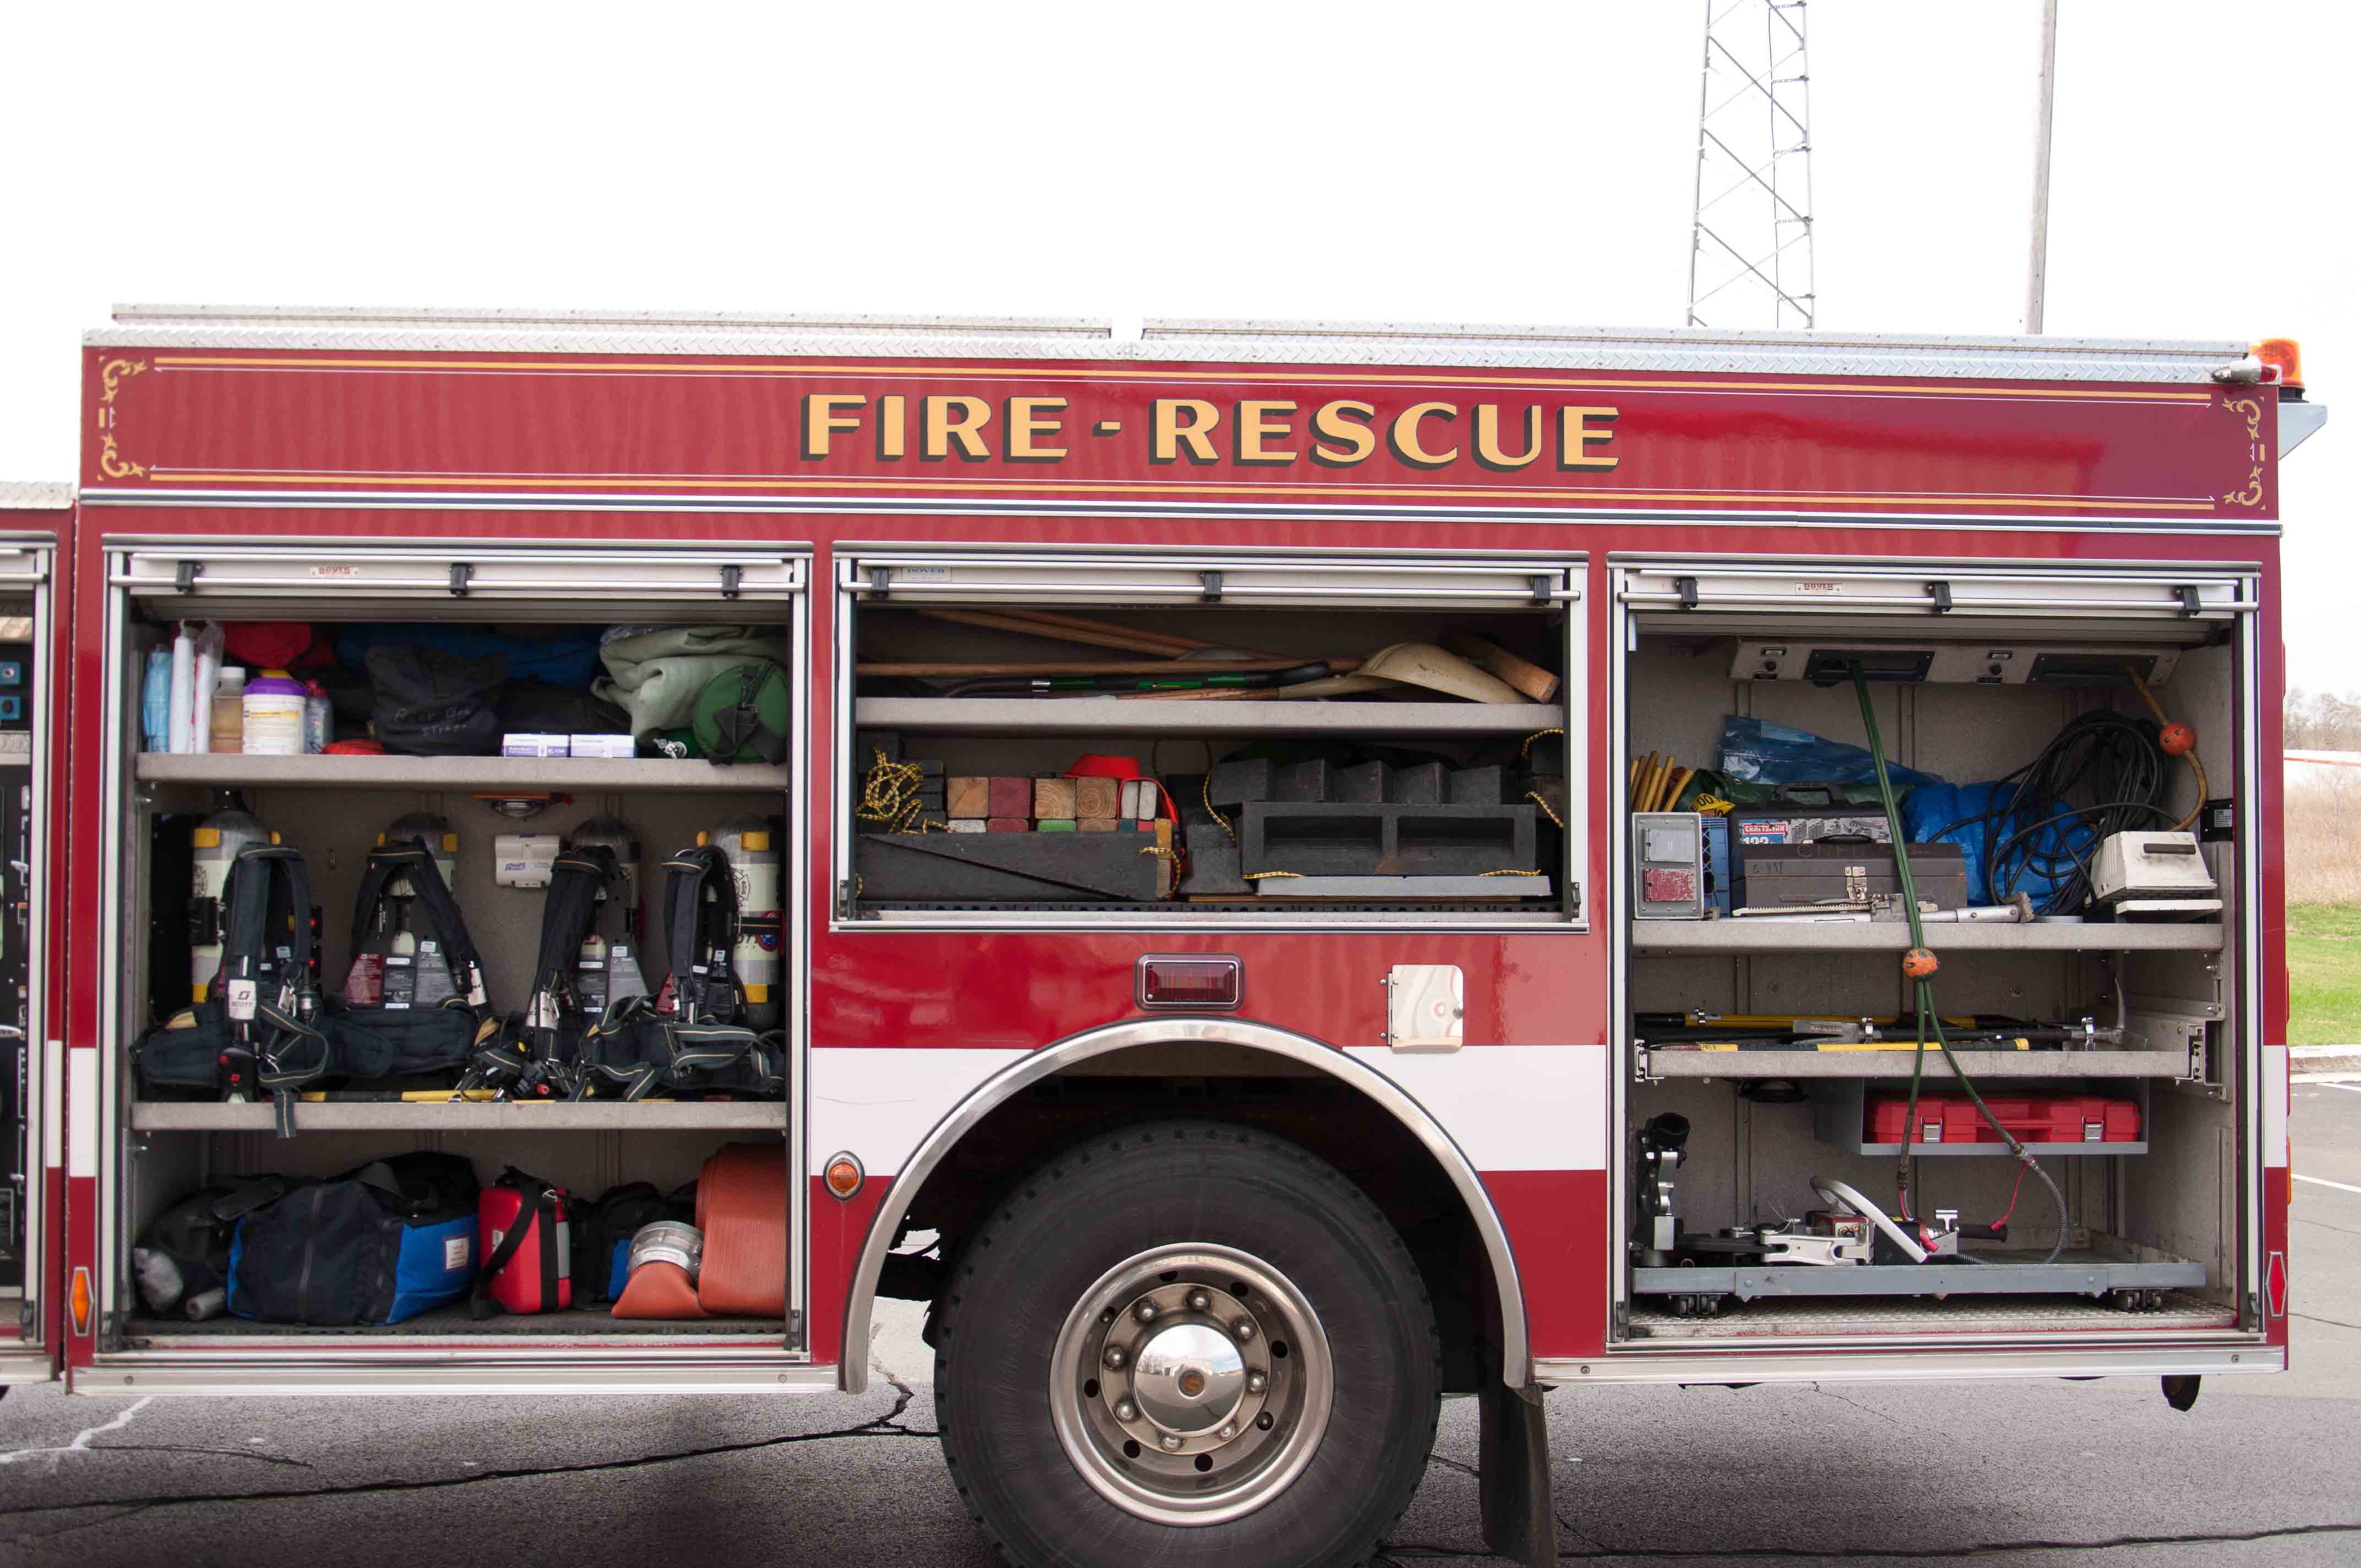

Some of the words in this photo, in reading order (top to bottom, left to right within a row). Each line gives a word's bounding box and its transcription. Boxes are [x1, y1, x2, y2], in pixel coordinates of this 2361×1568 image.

[801, 394, 1068, 464] FIRE
[1149, 399, 1620, 473] RESCUE
[1696, 794, 1714, 807] DO
